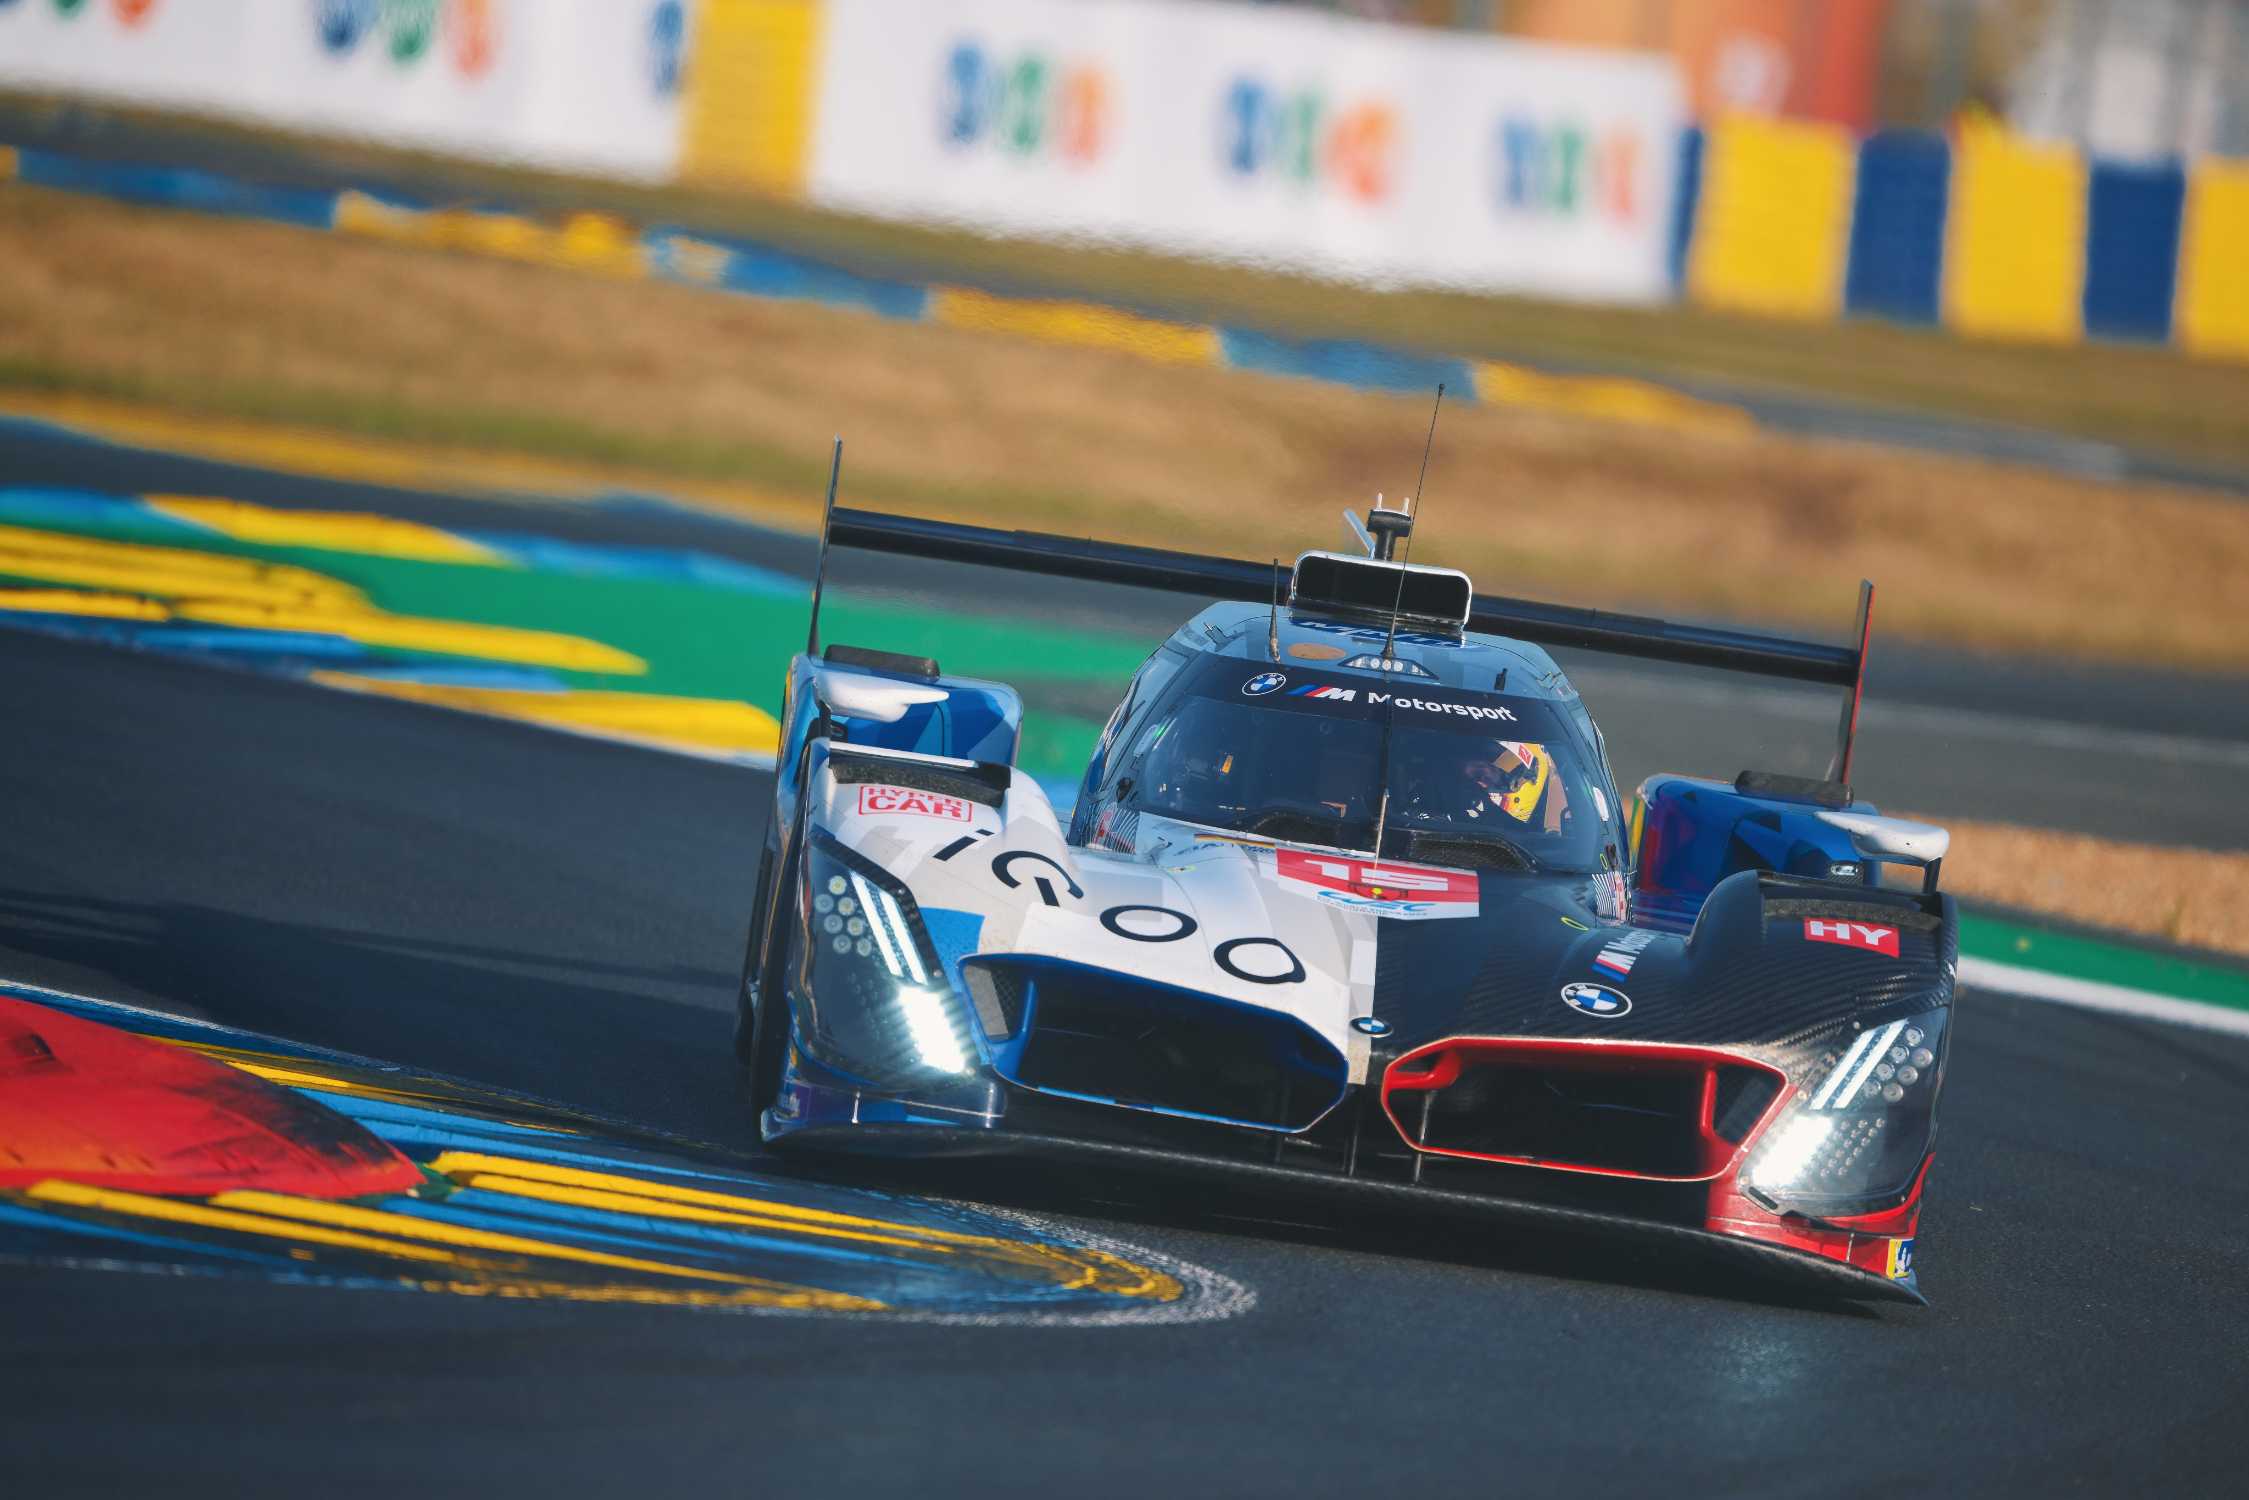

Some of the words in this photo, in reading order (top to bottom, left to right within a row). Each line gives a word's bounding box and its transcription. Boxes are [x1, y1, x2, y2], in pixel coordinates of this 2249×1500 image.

[1367, 692, 1519, 721] Motorsport
[867, 796, 963, 818] CAR
[1304, 859, 1449, 892] 15
[1809, 920, 1892, 945] HY
